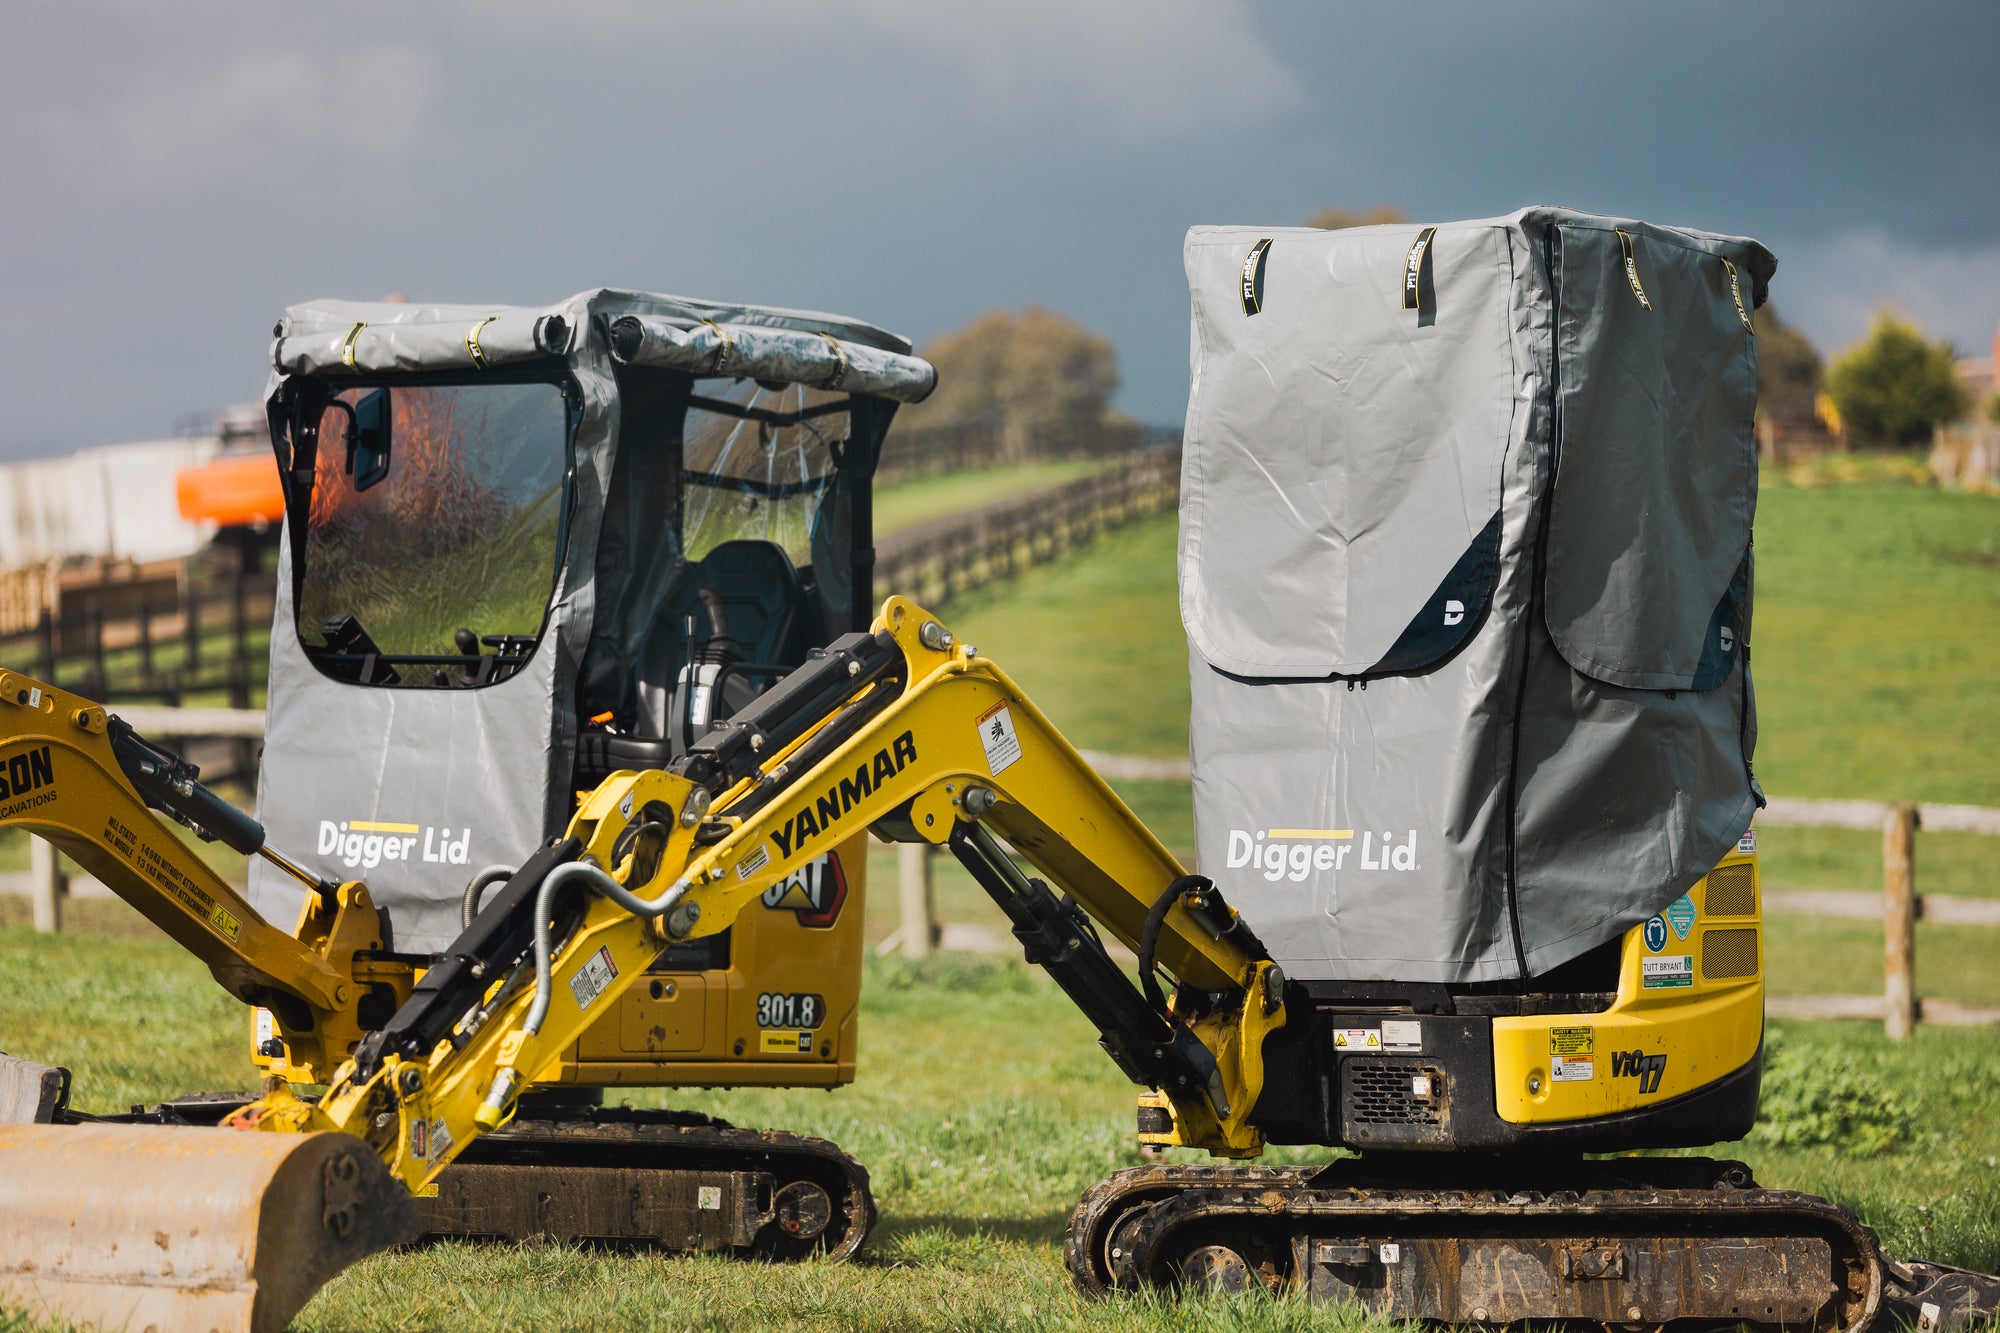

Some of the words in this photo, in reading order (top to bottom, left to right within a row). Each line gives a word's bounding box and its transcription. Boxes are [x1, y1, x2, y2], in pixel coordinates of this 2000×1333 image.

[1244, 250, 1260, 280] Digger
[1408, 241, 1425, 271] Digger
[0, 790, 58, 819] CAVATIONS
[770, 730, 917, 860] YANMAR
[317, 820, 418, 869] Digger
[1226, 829, 1353, 882] Digger
[119, 825, 138, 845] STATIC
[141, 843, 162, 864] 149KG
[160, 859, 184, 883] WITHOUT
[182, 875, 215, 908] ATTACHMENT
[156, 870, 179, 896] WITHOUT
[178, 888, 211, 921] ATTACHMENT
[1643, 963, 1659, 972] TUTT
[1659, 962, 1682, 971] BRYANT
[758, 994, 815, 1027] 301.8
